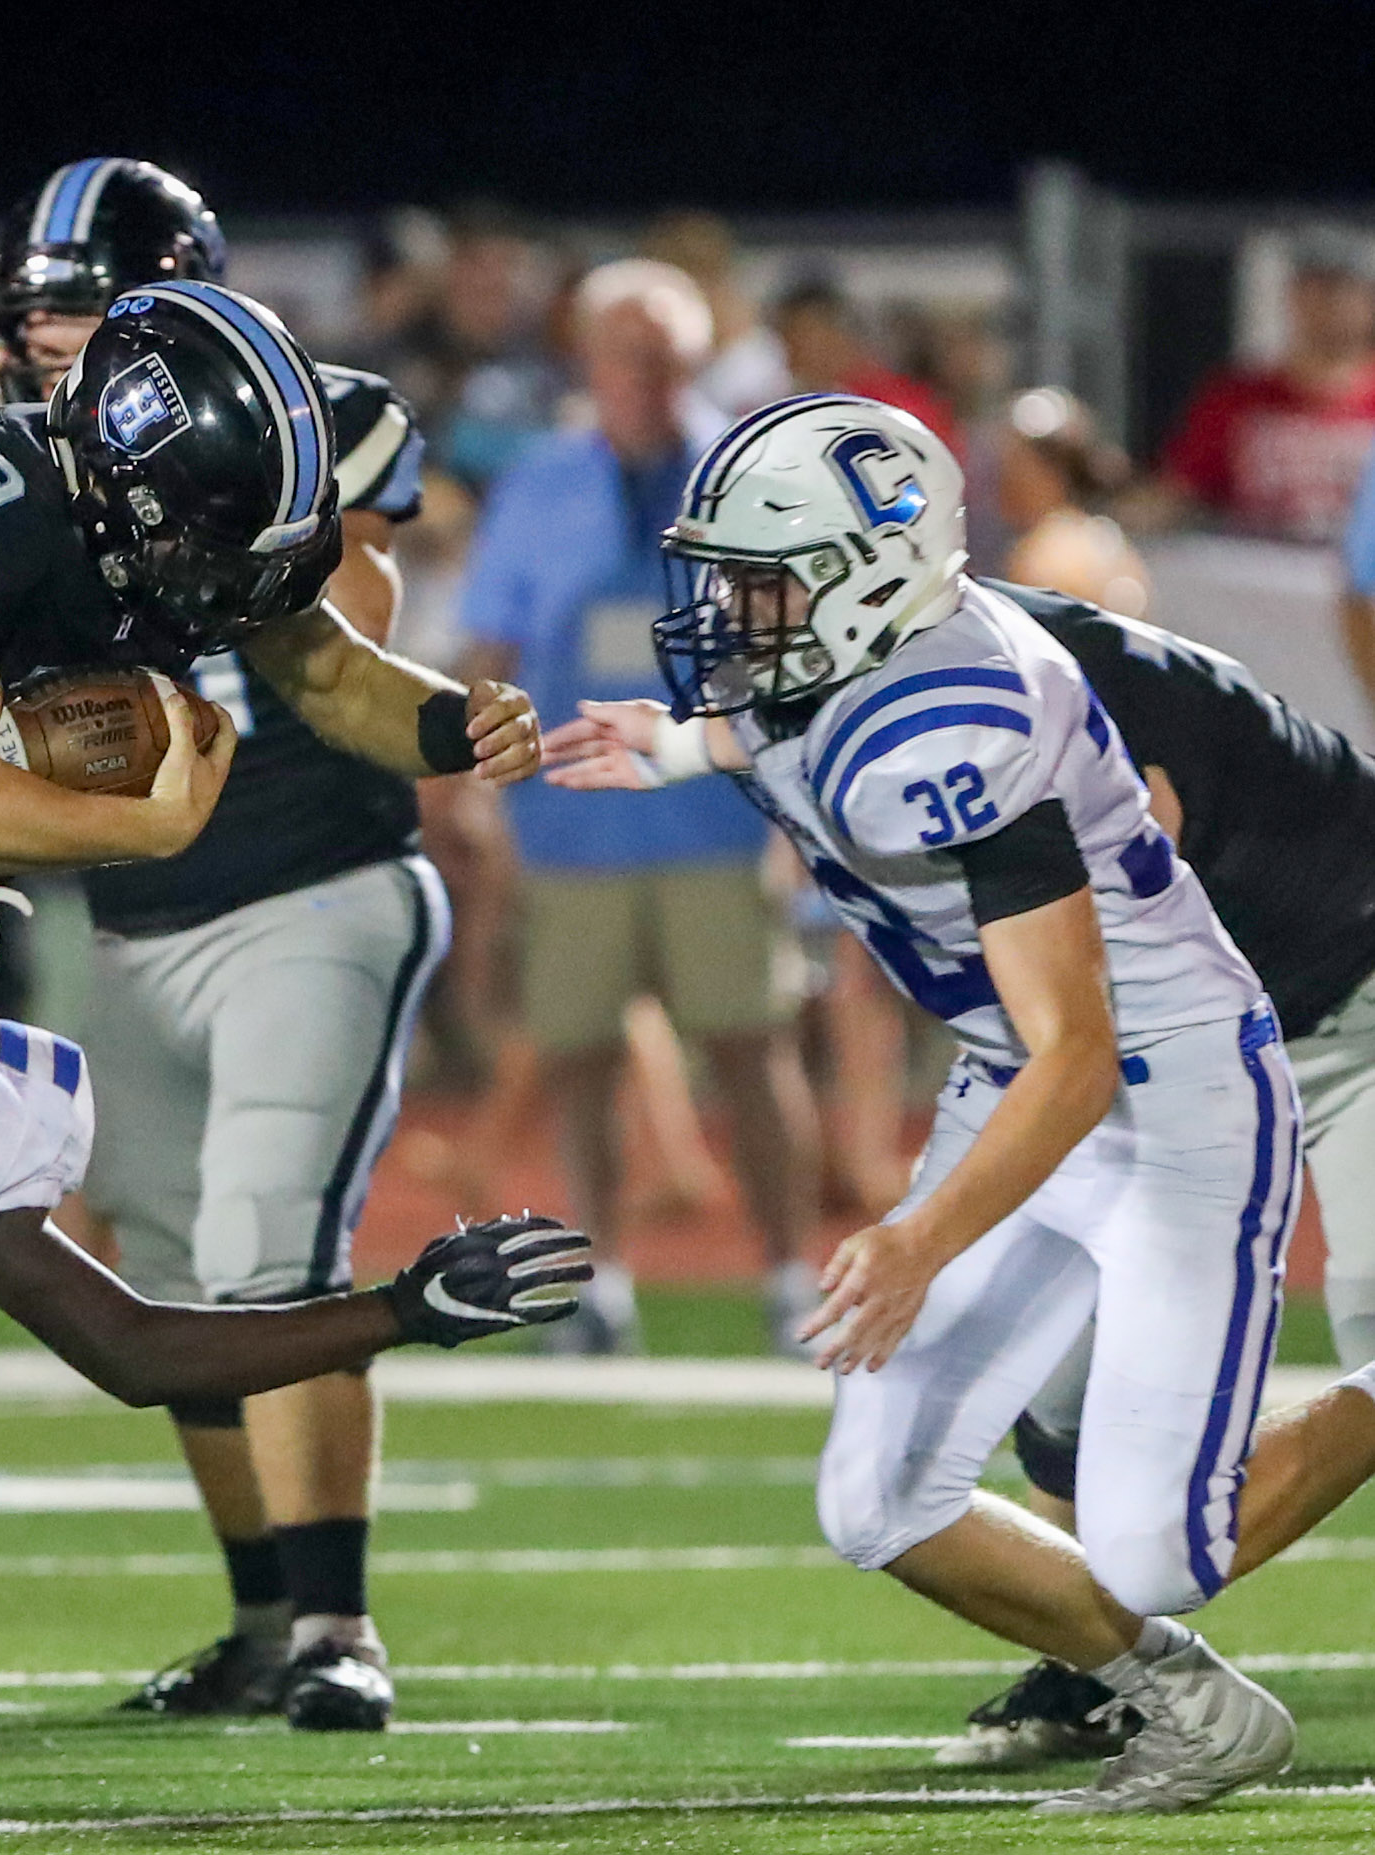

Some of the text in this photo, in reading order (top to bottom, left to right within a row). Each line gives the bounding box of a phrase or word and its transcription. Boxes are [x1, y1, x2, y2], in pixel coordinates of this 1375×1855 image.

[107, 375, 170, 447] H
[145, 358, 186, 427] HUSKIES
[820, 427, 928, 532] C
[52, 698, 133, 725] Wilson
[901, 761, 1001, 847] 32
